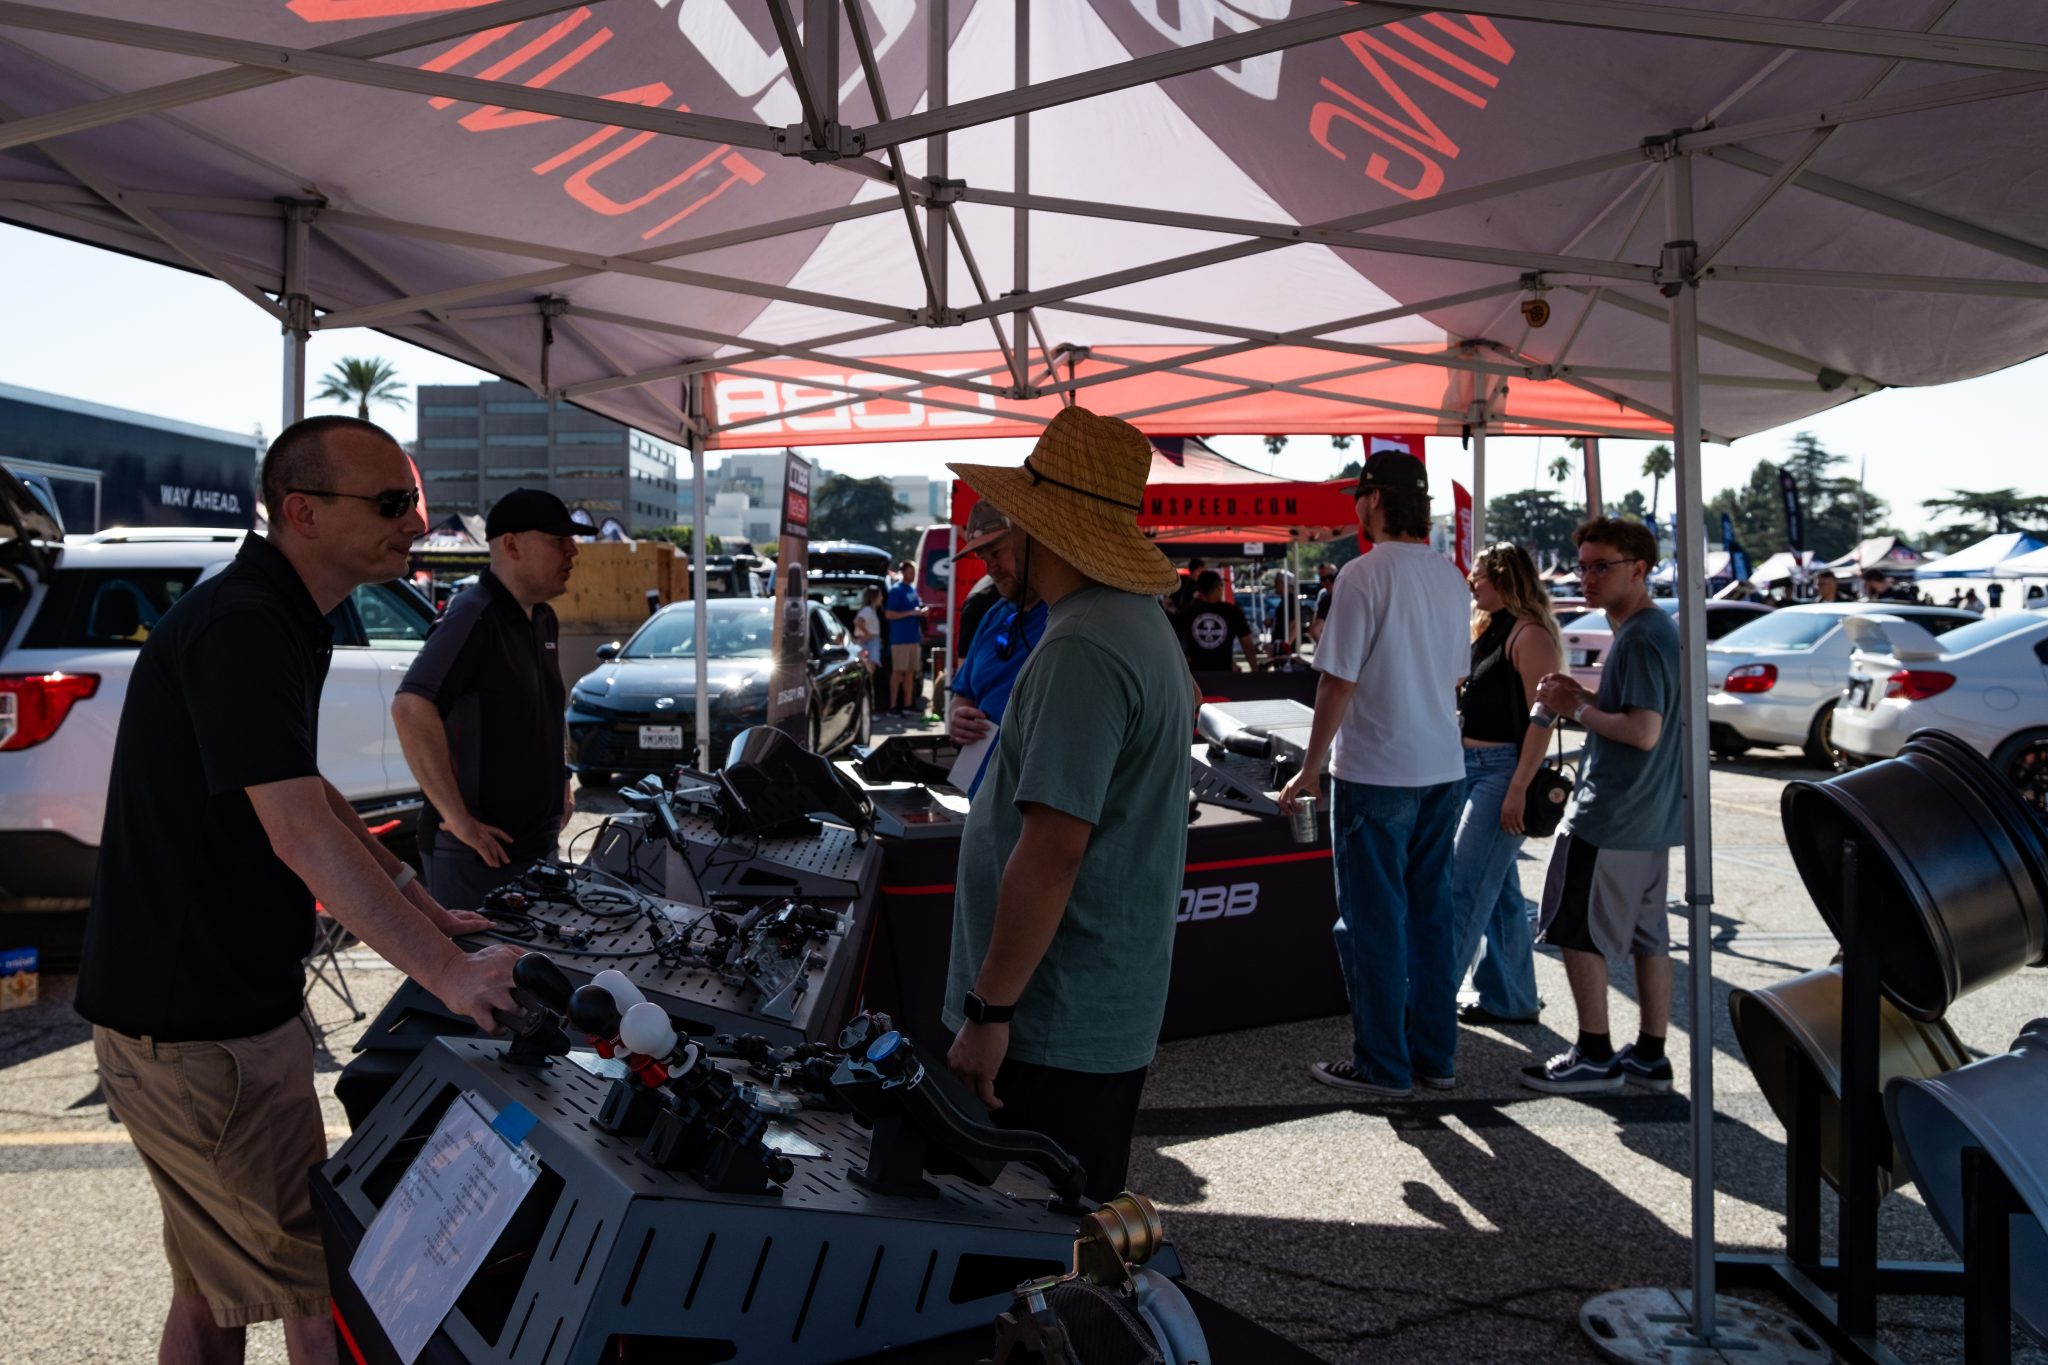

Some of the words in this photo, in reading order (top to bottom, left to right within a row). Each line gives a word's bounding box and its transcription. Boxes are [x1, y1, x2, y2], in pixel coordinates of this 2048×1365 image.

[160, 484, 190, 507] WAY
[192, 488, 241, 513] AHEAD.
[1176, 881, 1260, 923] OBB
